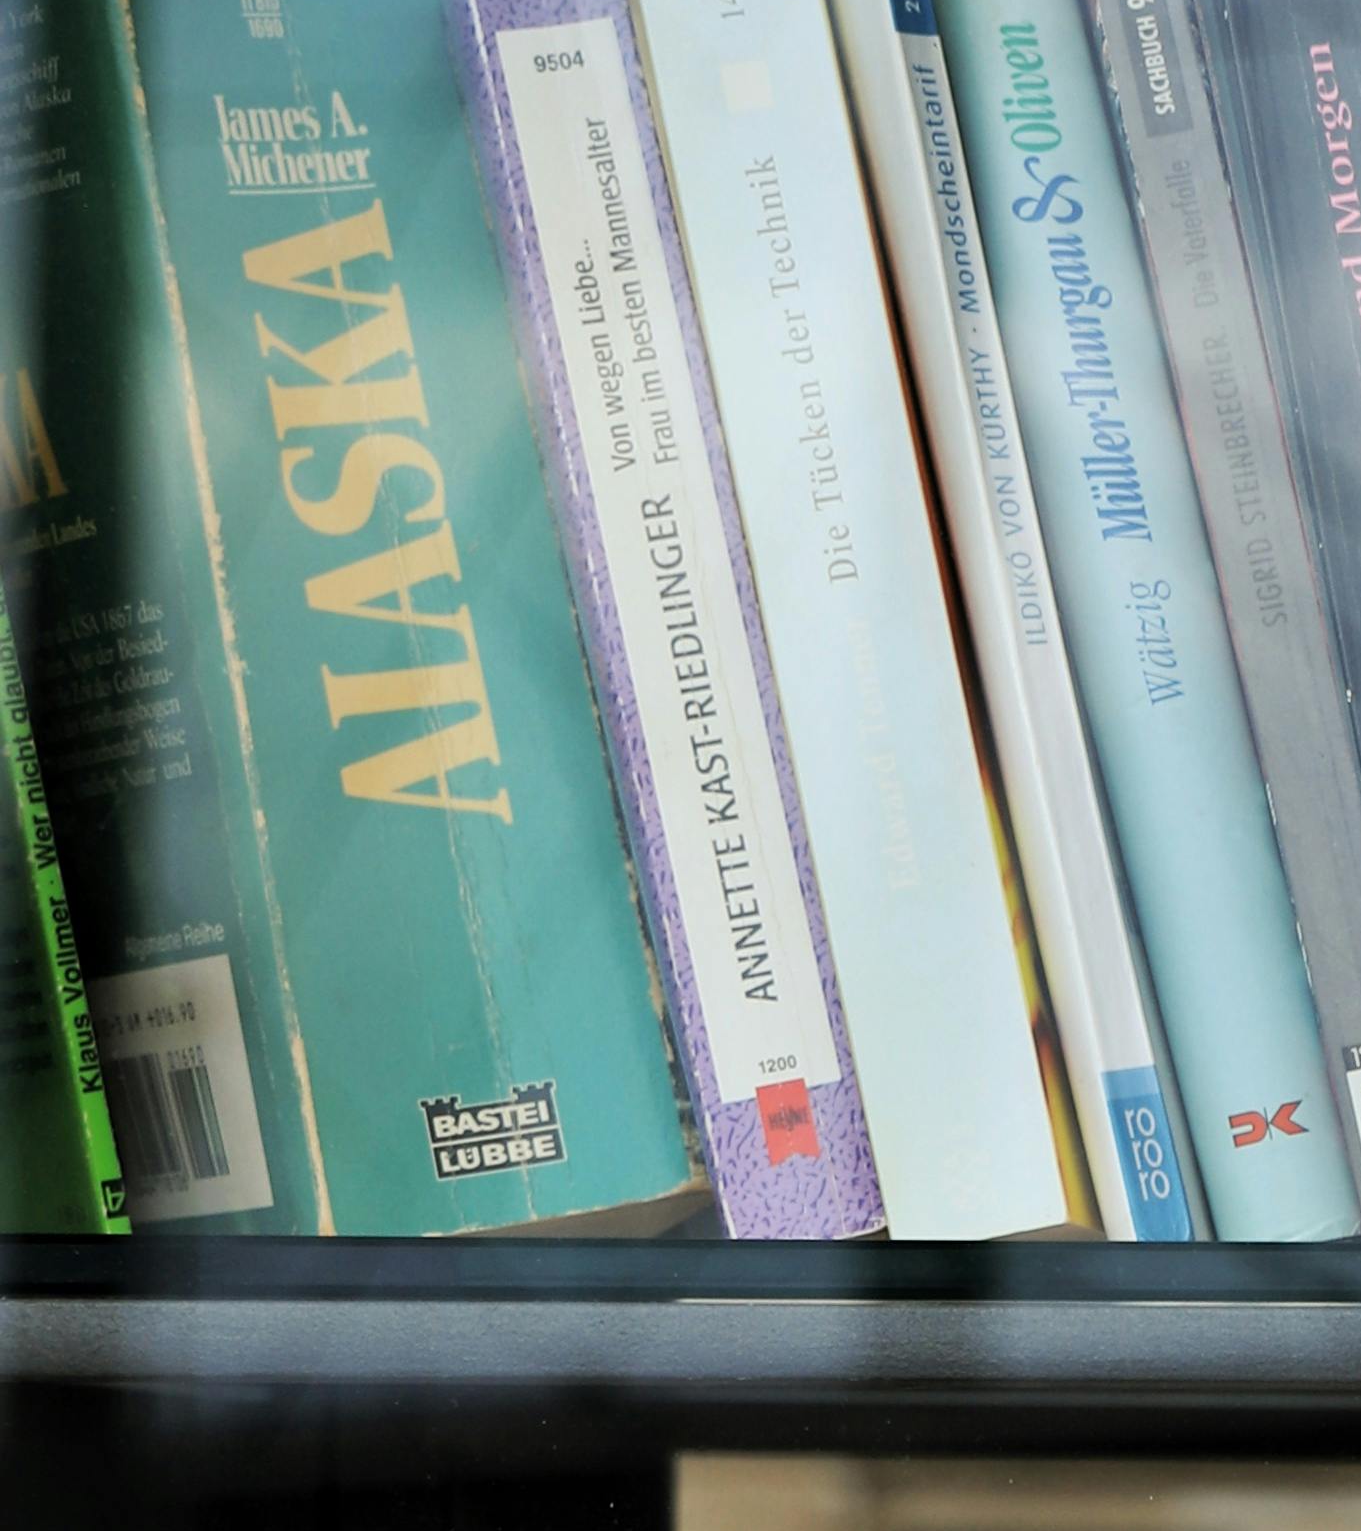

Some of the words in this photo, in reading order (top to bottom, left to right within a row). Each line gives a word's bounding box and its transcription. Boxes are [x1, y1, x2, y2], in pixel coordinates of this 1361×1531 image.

[533, 49, 585, 72] 9504
[1000, 23, 1062, 153] Oliven
[1137, 13, 1175, 115] SACHBUCH
[214, 94, 322, 142] James
[331, 90, 367, 137] A.
[225, 142, 371, 186] Michener
[587, 118, 630, 274] Mannesalter
[1013, 158, 1084, 225] &
[745, 156, 800, 301] Technik
[624, 279, 661, 361] besten
[782, 311, 815, 364] der
[591, 331, 623, 416] wegen
[639, 366, 666, 399] im
[1047, 232, 1151, 544] Müller-Thurgau
[610, 421, 637, 473] Von
[652, 408, 680, 464] Frau
[797, 380, 845, 512] Tücken
[242, 198, 513, 826] ALASKA
[827, 524, 859, 585] Die
[640, 493, 743, 827] KAST-RIEDLINGER
[717, 834, 777, 1003] ANNETTE
[434, 1096, 551, 1139] BASTEI
[438, 1134, 557, 1174] LÜBBE
